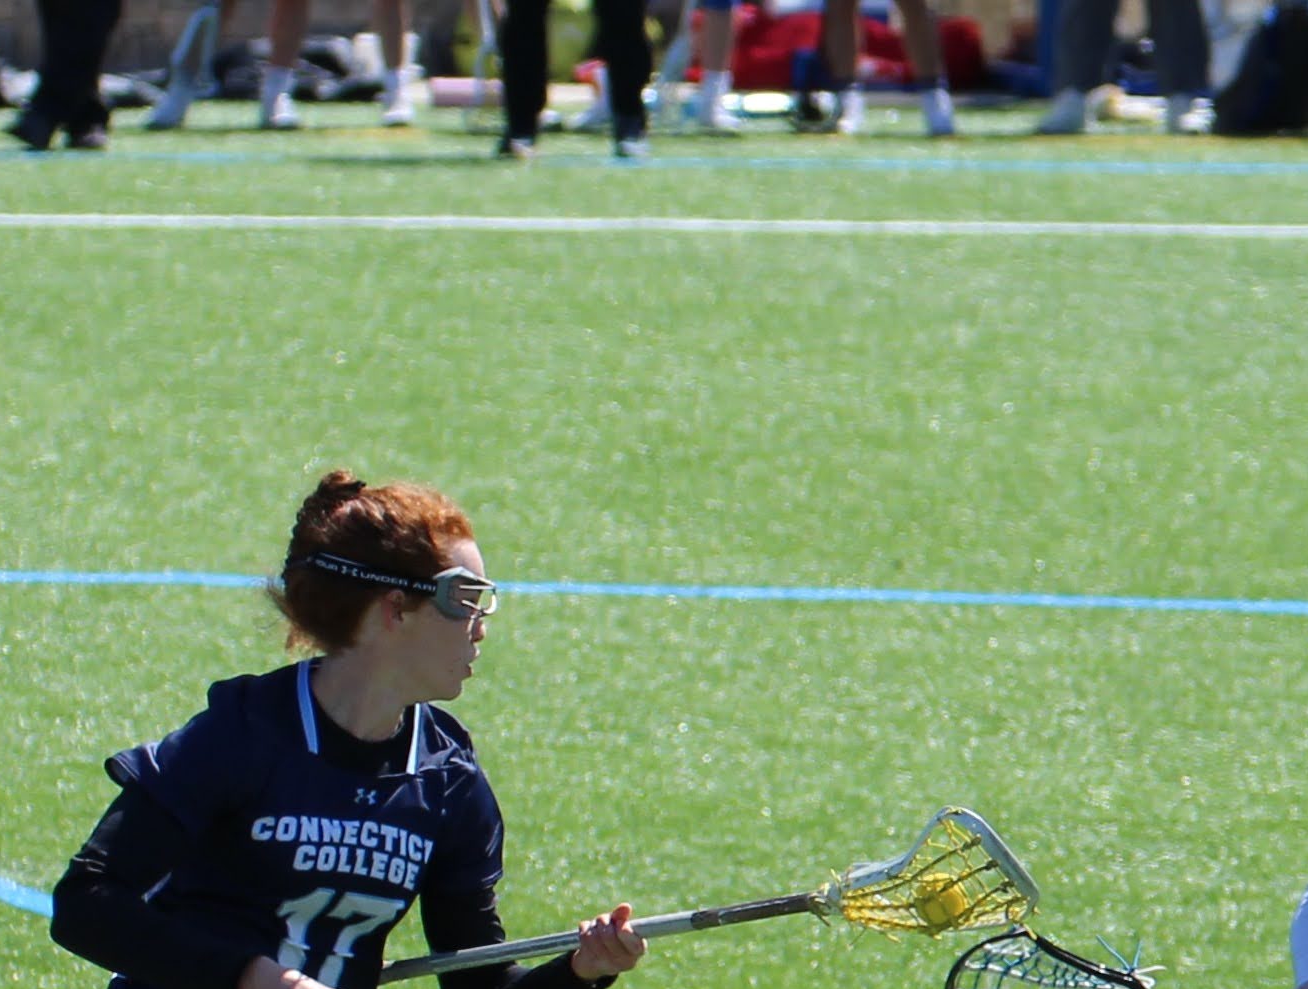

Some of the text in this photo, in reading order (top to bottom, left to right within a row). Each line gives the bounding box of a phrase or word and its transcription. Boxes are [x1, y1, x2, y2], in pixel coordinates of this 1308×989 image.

[359, 571, 408, 587] UNDER
[292, 844, 420, 892] COLLEGE
[276, 887, 406, 988] 17
